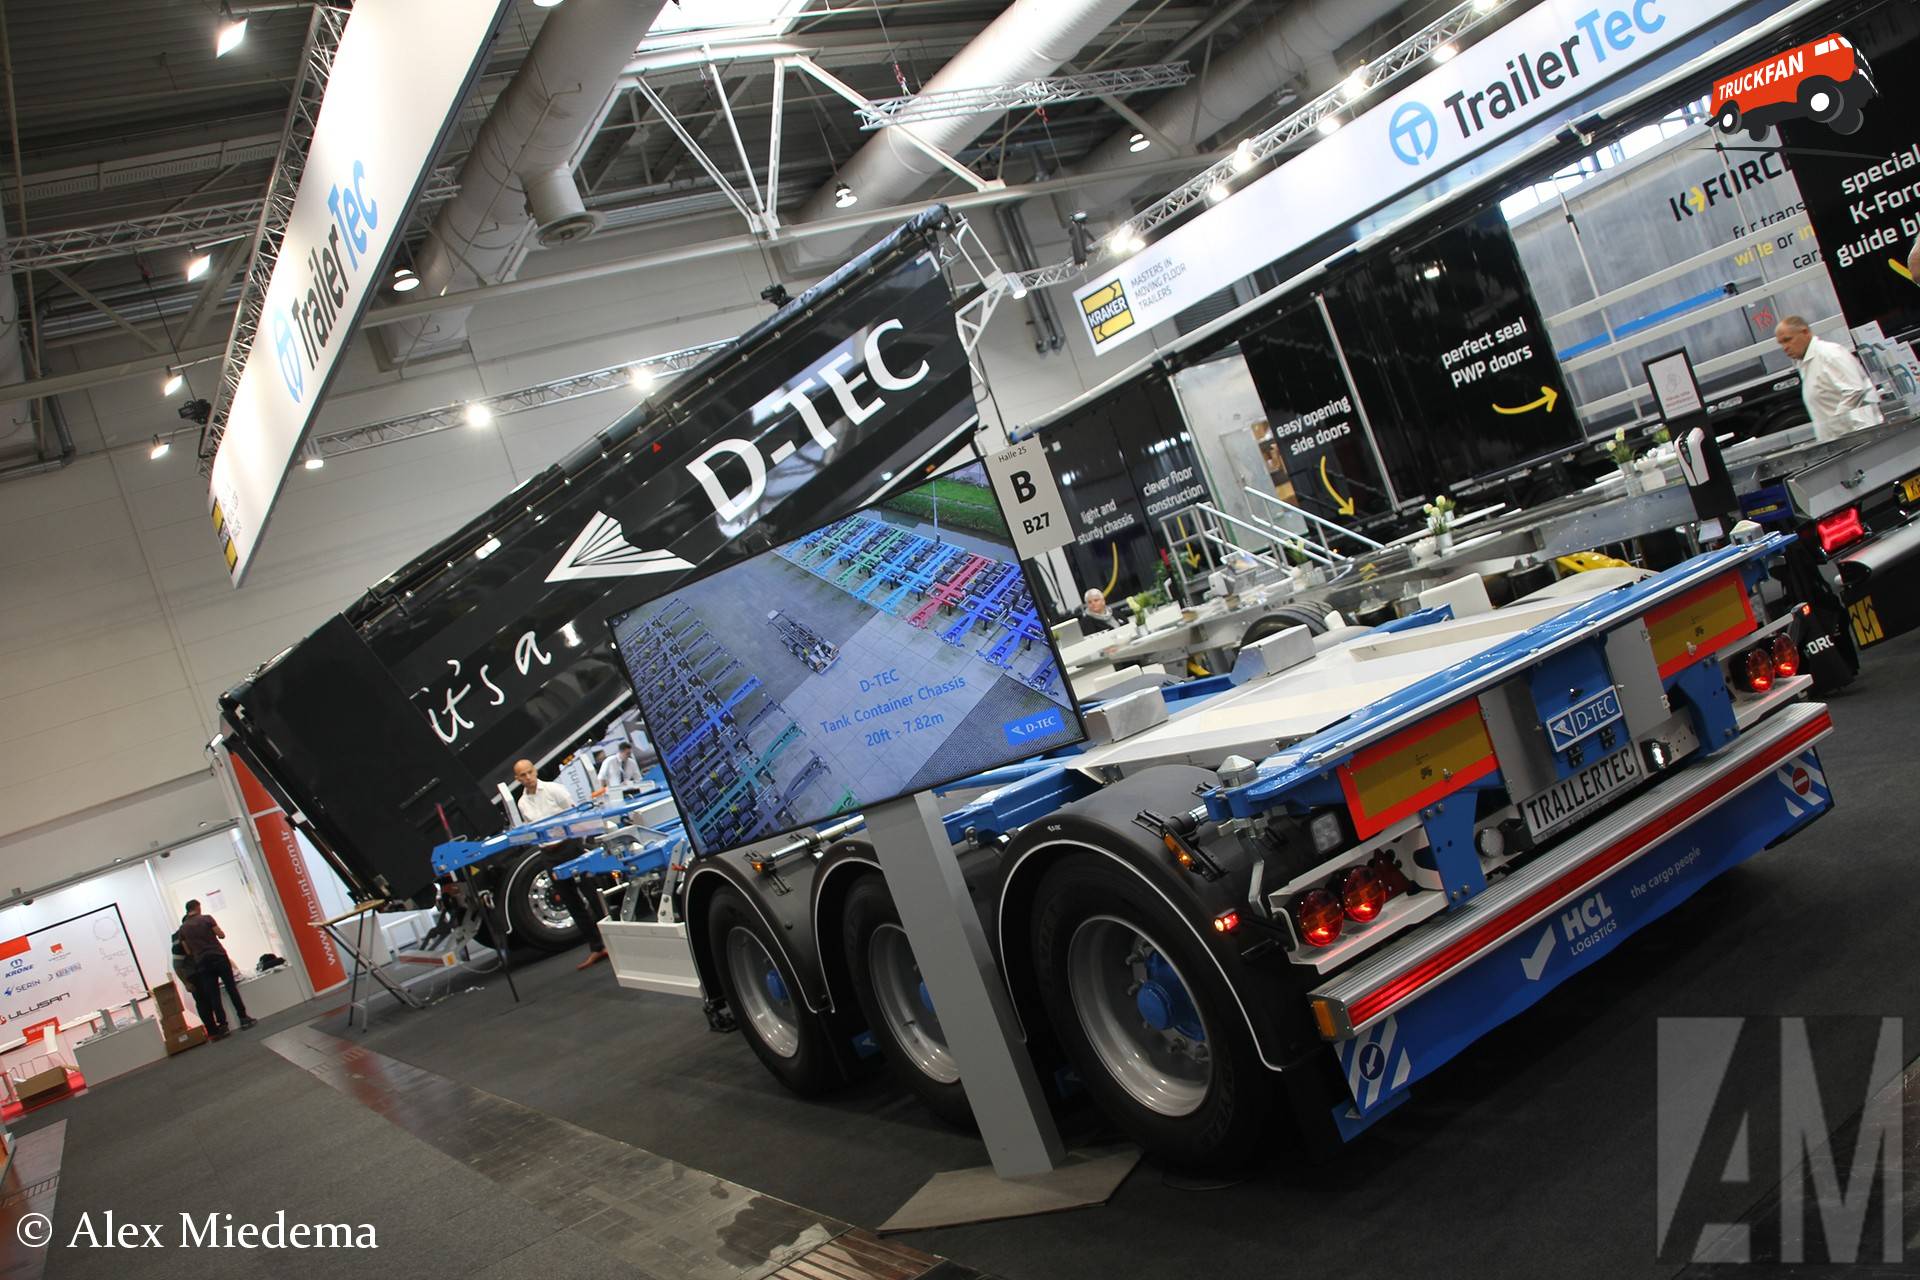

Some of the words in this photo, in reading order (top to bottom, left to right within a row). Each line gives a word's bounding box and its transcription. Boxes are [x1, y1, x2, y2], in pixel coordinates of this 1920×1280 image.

[1444, 0, 1666, 139] TrailerTec
[1841, 143, 1920, 195] special
[1777, 232, 1794, 249] or
[1836, 228, 1899, 267] guide
[291, 159, 378, 371] TrailerTec
[1130, 262, 1164, 288] MASTERS
[1164, 257, 1173, 268] IN
[1134, 279, 1161, 299] MOVING
[1161, 263, 1187, 283] FLOOR
[1087, 296, 1128, 328] KRAKER
[1138, 285, 1172, 310] TRAILERS
[1441, 332, 1494, 369] perfect
[1495, 316, 1528, 343] seal
[1451, 360, 1486, 388] PWP
[1489, 345, 1533, 374] doors
[686, 318, 931, 522] D-TEC
[1276, 417, 1302, 438] easy
[1303, 395, 1352, 427] opening
[998, 450, 1016, 463] Halle
[1017, 446, 1027, 456] 25
[1290, 436, 1315, 455] side
[1315, 422, 1351, 445] doors
[1010, 470, 1037, 504] B
[1143, 475, 1169, 497] clever
[1170, 466, 1193, 485] floor
[1080, 508, 1101, 525] light
[1100, 498, 1117, 515] and
[1146, 484, 1204, 516] construction
[1022, 511, 1050, 535] B27
[1077, 526, 1104, 545] sturdy
[1103, 512, 1135, 535] chassis
[420, 659, 505, 744] it's
[515, 630, 552, 676] a
[858, 668, 900, 694] D-TEC
[820, 718, 851, 735] Tank
[854, 692, 914, 723] Container
[917, 675, 967, 701] Chassis
[1575, 695, 1616, 730] D-TEC
[865, 727, 893, 747] 20ft
[903, 712, 945, 735] 7.82m
[1025, 715, 1057, 733] D-TEC
[1527, 749, 1635, 829] TRAILERTEC
[1630, 883, 1648, 898] the
[1648, 866, 1674, 888] cargo
[1674, 847, 1701, 875] people
[1561, 891, 1614, 941] HCL
[1570, 920, 1617, 956] LOGISTICS
[5, 963, 34, 978] KRONE
[15, 978, 40, 993] SERIN
